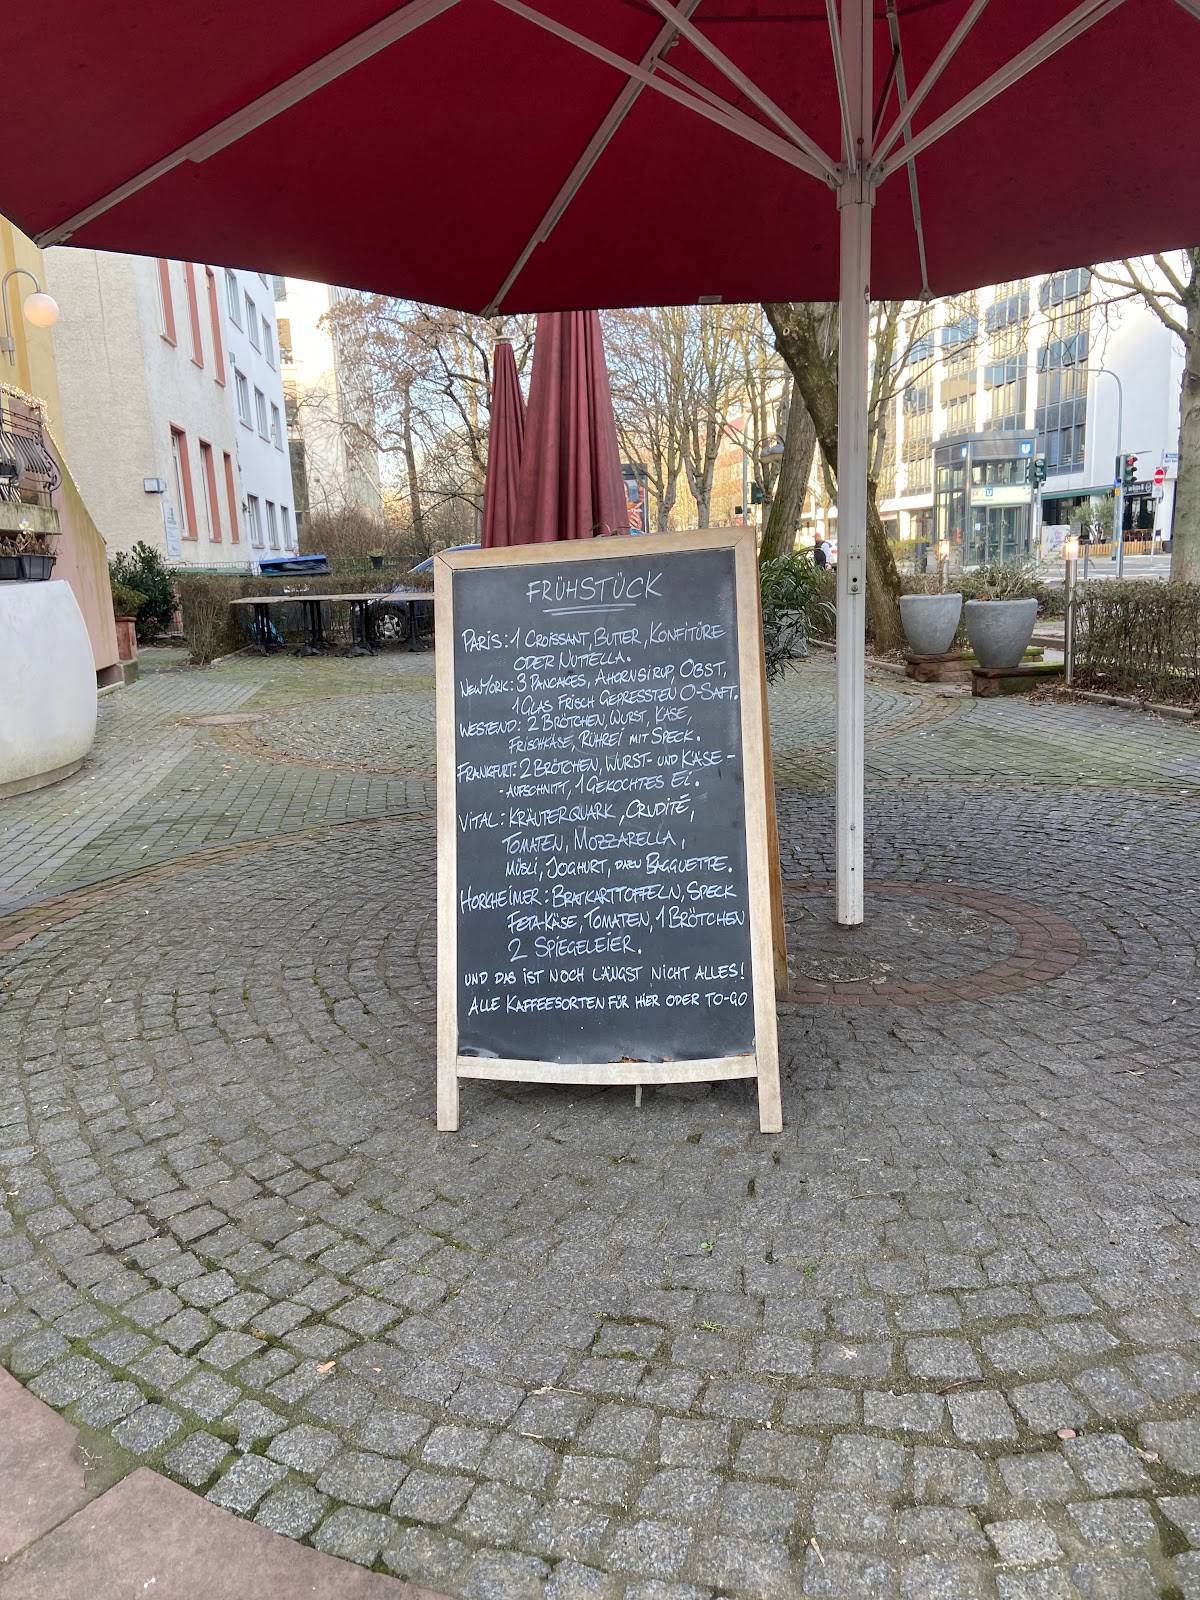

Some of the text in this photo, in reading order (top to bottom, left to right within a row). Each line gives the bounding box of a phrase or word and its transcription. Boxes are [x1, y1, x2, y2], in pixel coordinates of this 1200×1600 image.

[526, 570, 662, 603] FRÜHSTÜCK
[461, 621, 727, 653] PARIS: 1 CROISSANT, BUTTER, KONFITÜRE
[513, 649, 632, 671] ODER NUTTELLA.
[516, 672, 527, 692] 3
[529, 673, 591, 692] PANCAKES,
[594, 664, 675, 686] AHORNSIRUP,
[680, 658, 727, 679] OBST,
[520, 695, 554, 716] GLAS
[557, 693, 595, 711] FRISCH
[599, 687, 677, 707] GEPRESSTEN
[680, 682, 739, 701] O-SAFT.
[459, 719, 521, 738] WESTEND:
[527, 715, 540, 732] 2
[541, 713, 608, 731] BRÖTCHEN,
[609, 709, 650, 727] WURST,
[578, 727, 625, 748] RÜHREI
[629, 733, 650, 746] MIT
[651, 726, 701, 745] SPECK.
[457, 760, 518, 784] FRANKFURT:
[519, 758, 532, 780] 2
[533, 758, 603, 777] BRÖTCHEN,
[605, 751, 653, 773] WURST-
[656, 755, 678, 767] UND
[575, 774, 584, 794] 1
[586, 774, 664, 795] GEKOCHTES
[458, 811, 506, 833] VITAL:
[501, 826, 686, 855] TOMATEN, MOZZARELLA,
[504, 856, 544, 882] MÜSLI,
[545, 855, 612, 879] JOGHURT,
[686, 880, 737, 901] SPECK
[583, 905, 654, 934] TOMATEN,
[655, 904, 666, 929] 1
[667, 905, 746, 929] BRÖTCHEN
[507, 931, 643, 963] 2 SPIEGELEIER.
[463, 961, 746, 987] UND DAS IST NOCH LÄNGST NICHT ALLES!
[467, 991, 748, 1017] ALLE KAFFEESORTEN FÜR HIER ODER TO-GO
